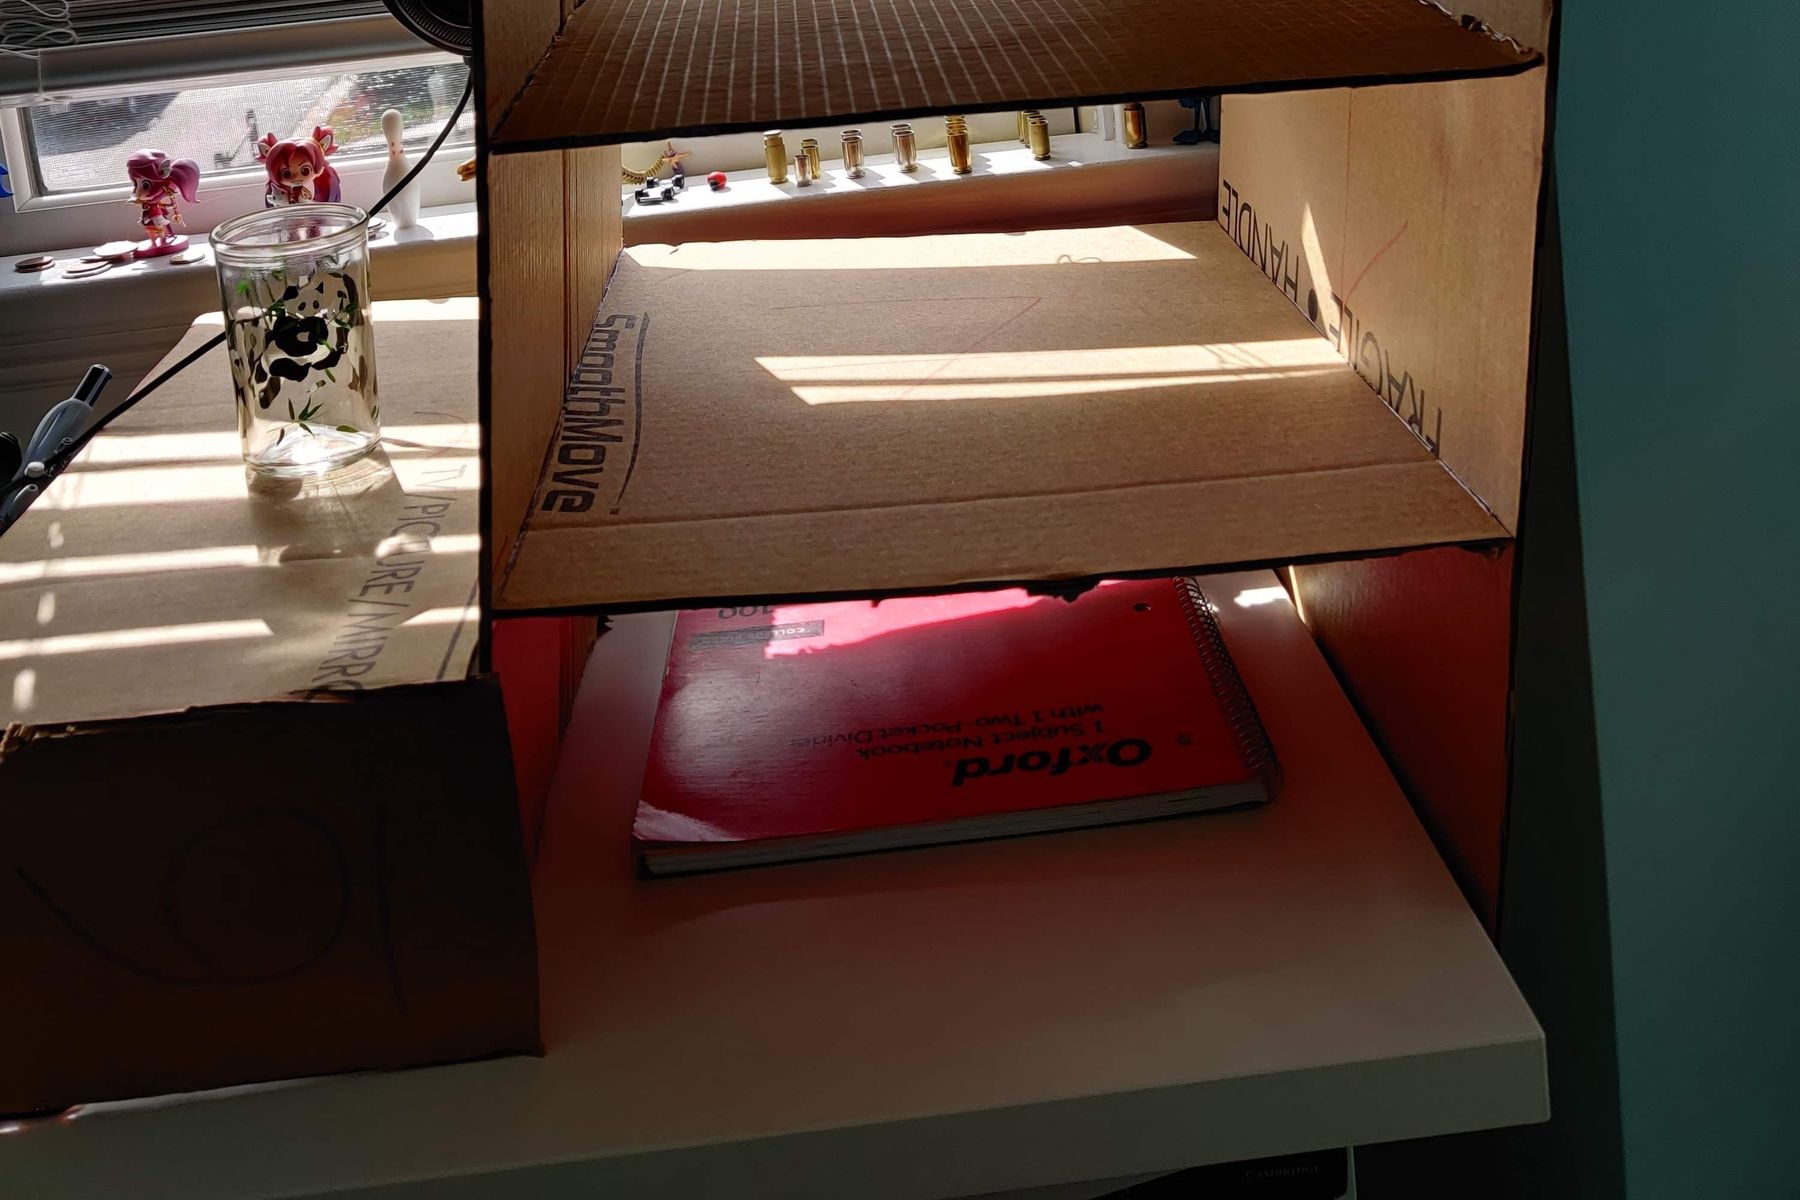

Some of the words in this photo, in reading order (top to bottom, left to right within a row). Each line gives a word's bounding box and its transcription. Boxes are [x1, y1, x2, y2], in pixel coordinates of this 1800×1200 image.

[1222, 179, 1300, 303] HANDLE
[541, 314, 637, 513] SmoothMove
[1050, 703, 1104, 721] with
[856, 736, 984, 760] Notebook
[992, 722, 1086, 745] Subject
[952, 738, 1153, 787] Oxford
